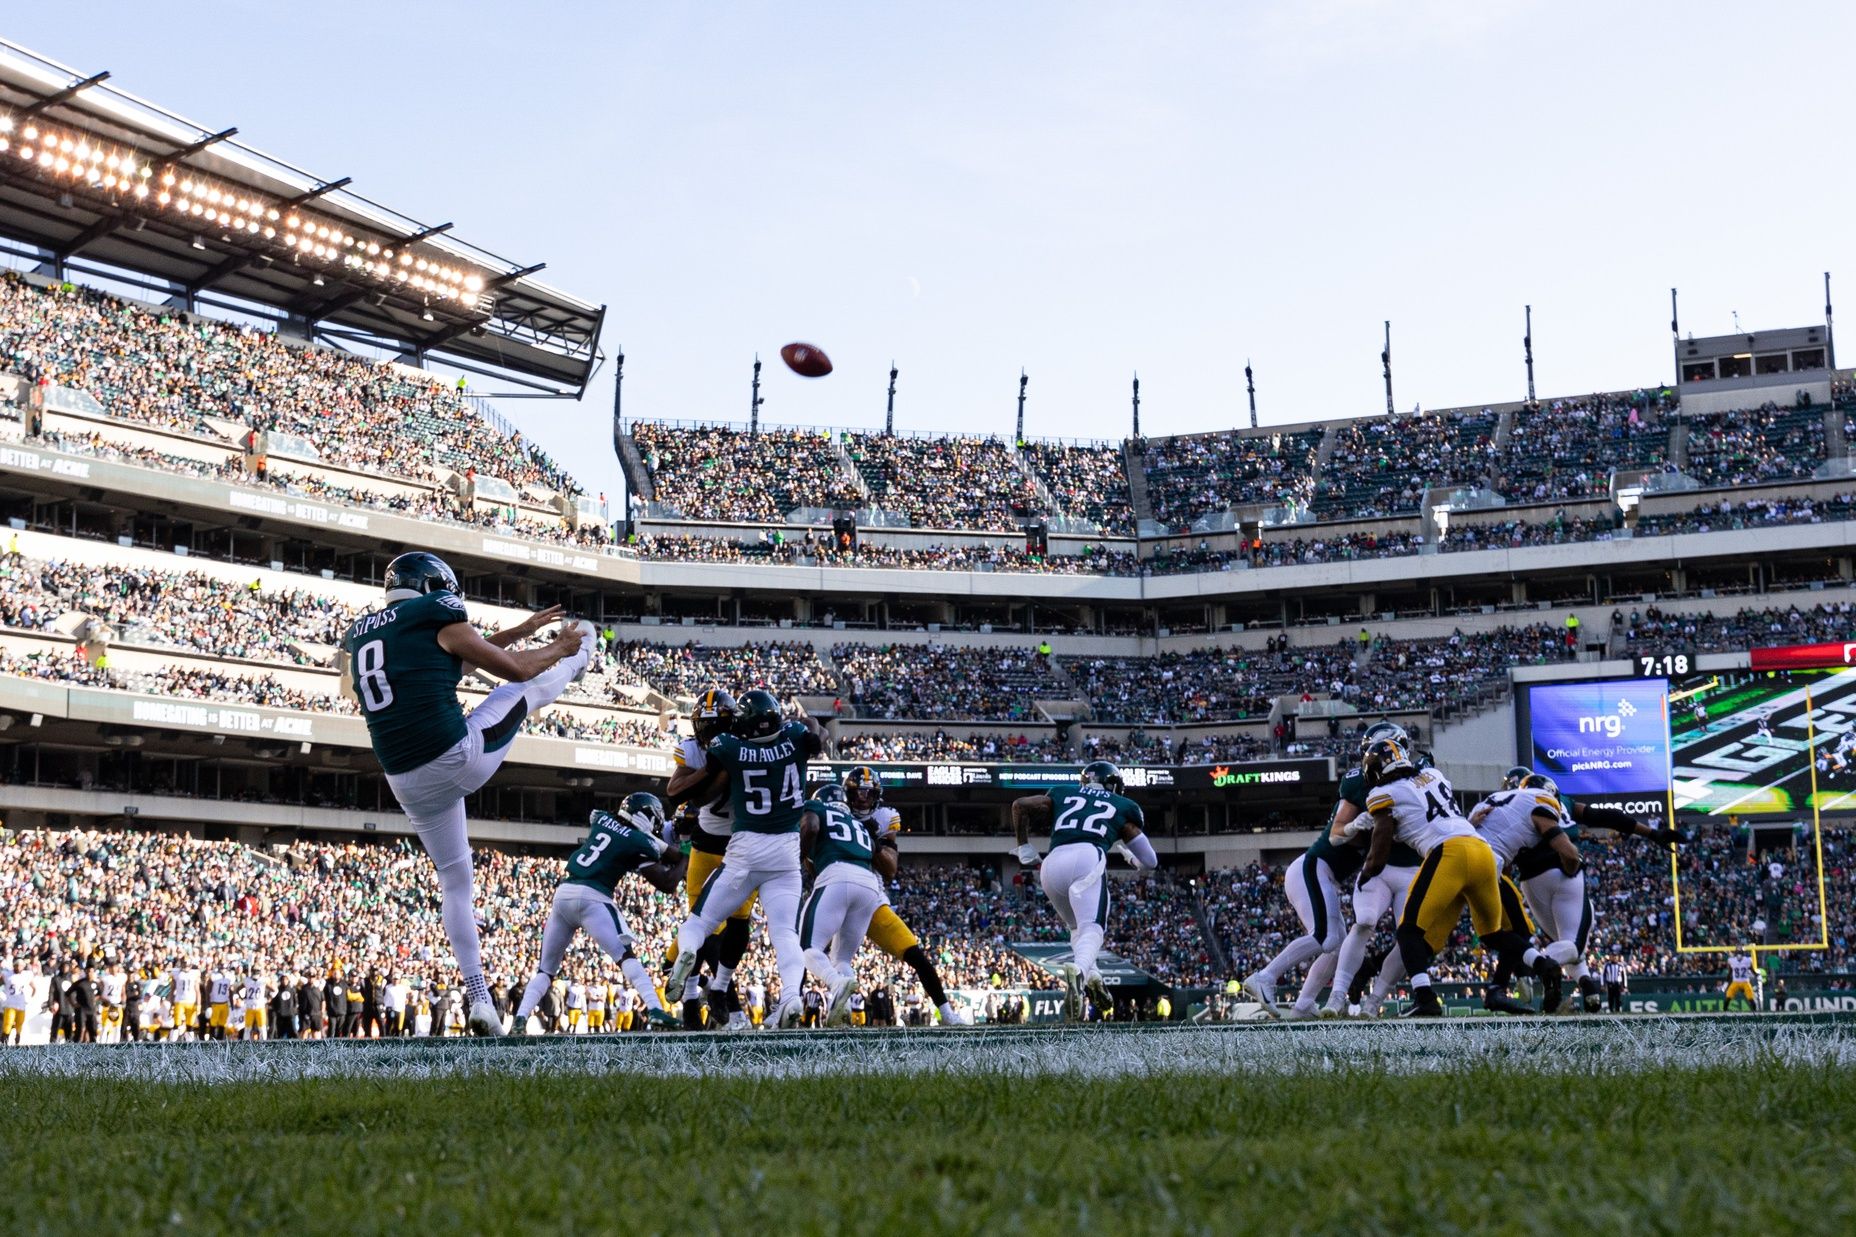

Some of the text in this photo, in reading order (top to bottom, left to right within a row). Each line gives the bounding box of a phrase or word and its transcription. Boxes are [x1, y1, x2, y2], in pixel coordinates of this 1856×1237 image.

[353, 606, 399, 639] SIPOSS
[357, 639, 394, 712] 8
[1641, 655, 1689, 676] 7:18
[219, 710, 260, 732] BETTER
[261, 718, 274, 728] AT
[1578, 714, 1622, 738] nrg
[739, 738, 796, 763] BRADLEY
[1547, 745, 1656, 759] Official Energy Provider
[1119, 767, 1146, 778] AGLES
[1571, 760, 1632, 772] pickNRG.com
[742, 762, 805, 815] 54
[1213, 770, 1301, 788] DRAFTKINGS
[597, 815, 632, 838] PASCAL
[1054, 796, 1117, 838] 22
[576, 832, 612, 868] 3
[1034, 999, 1065, 1016] FLY
